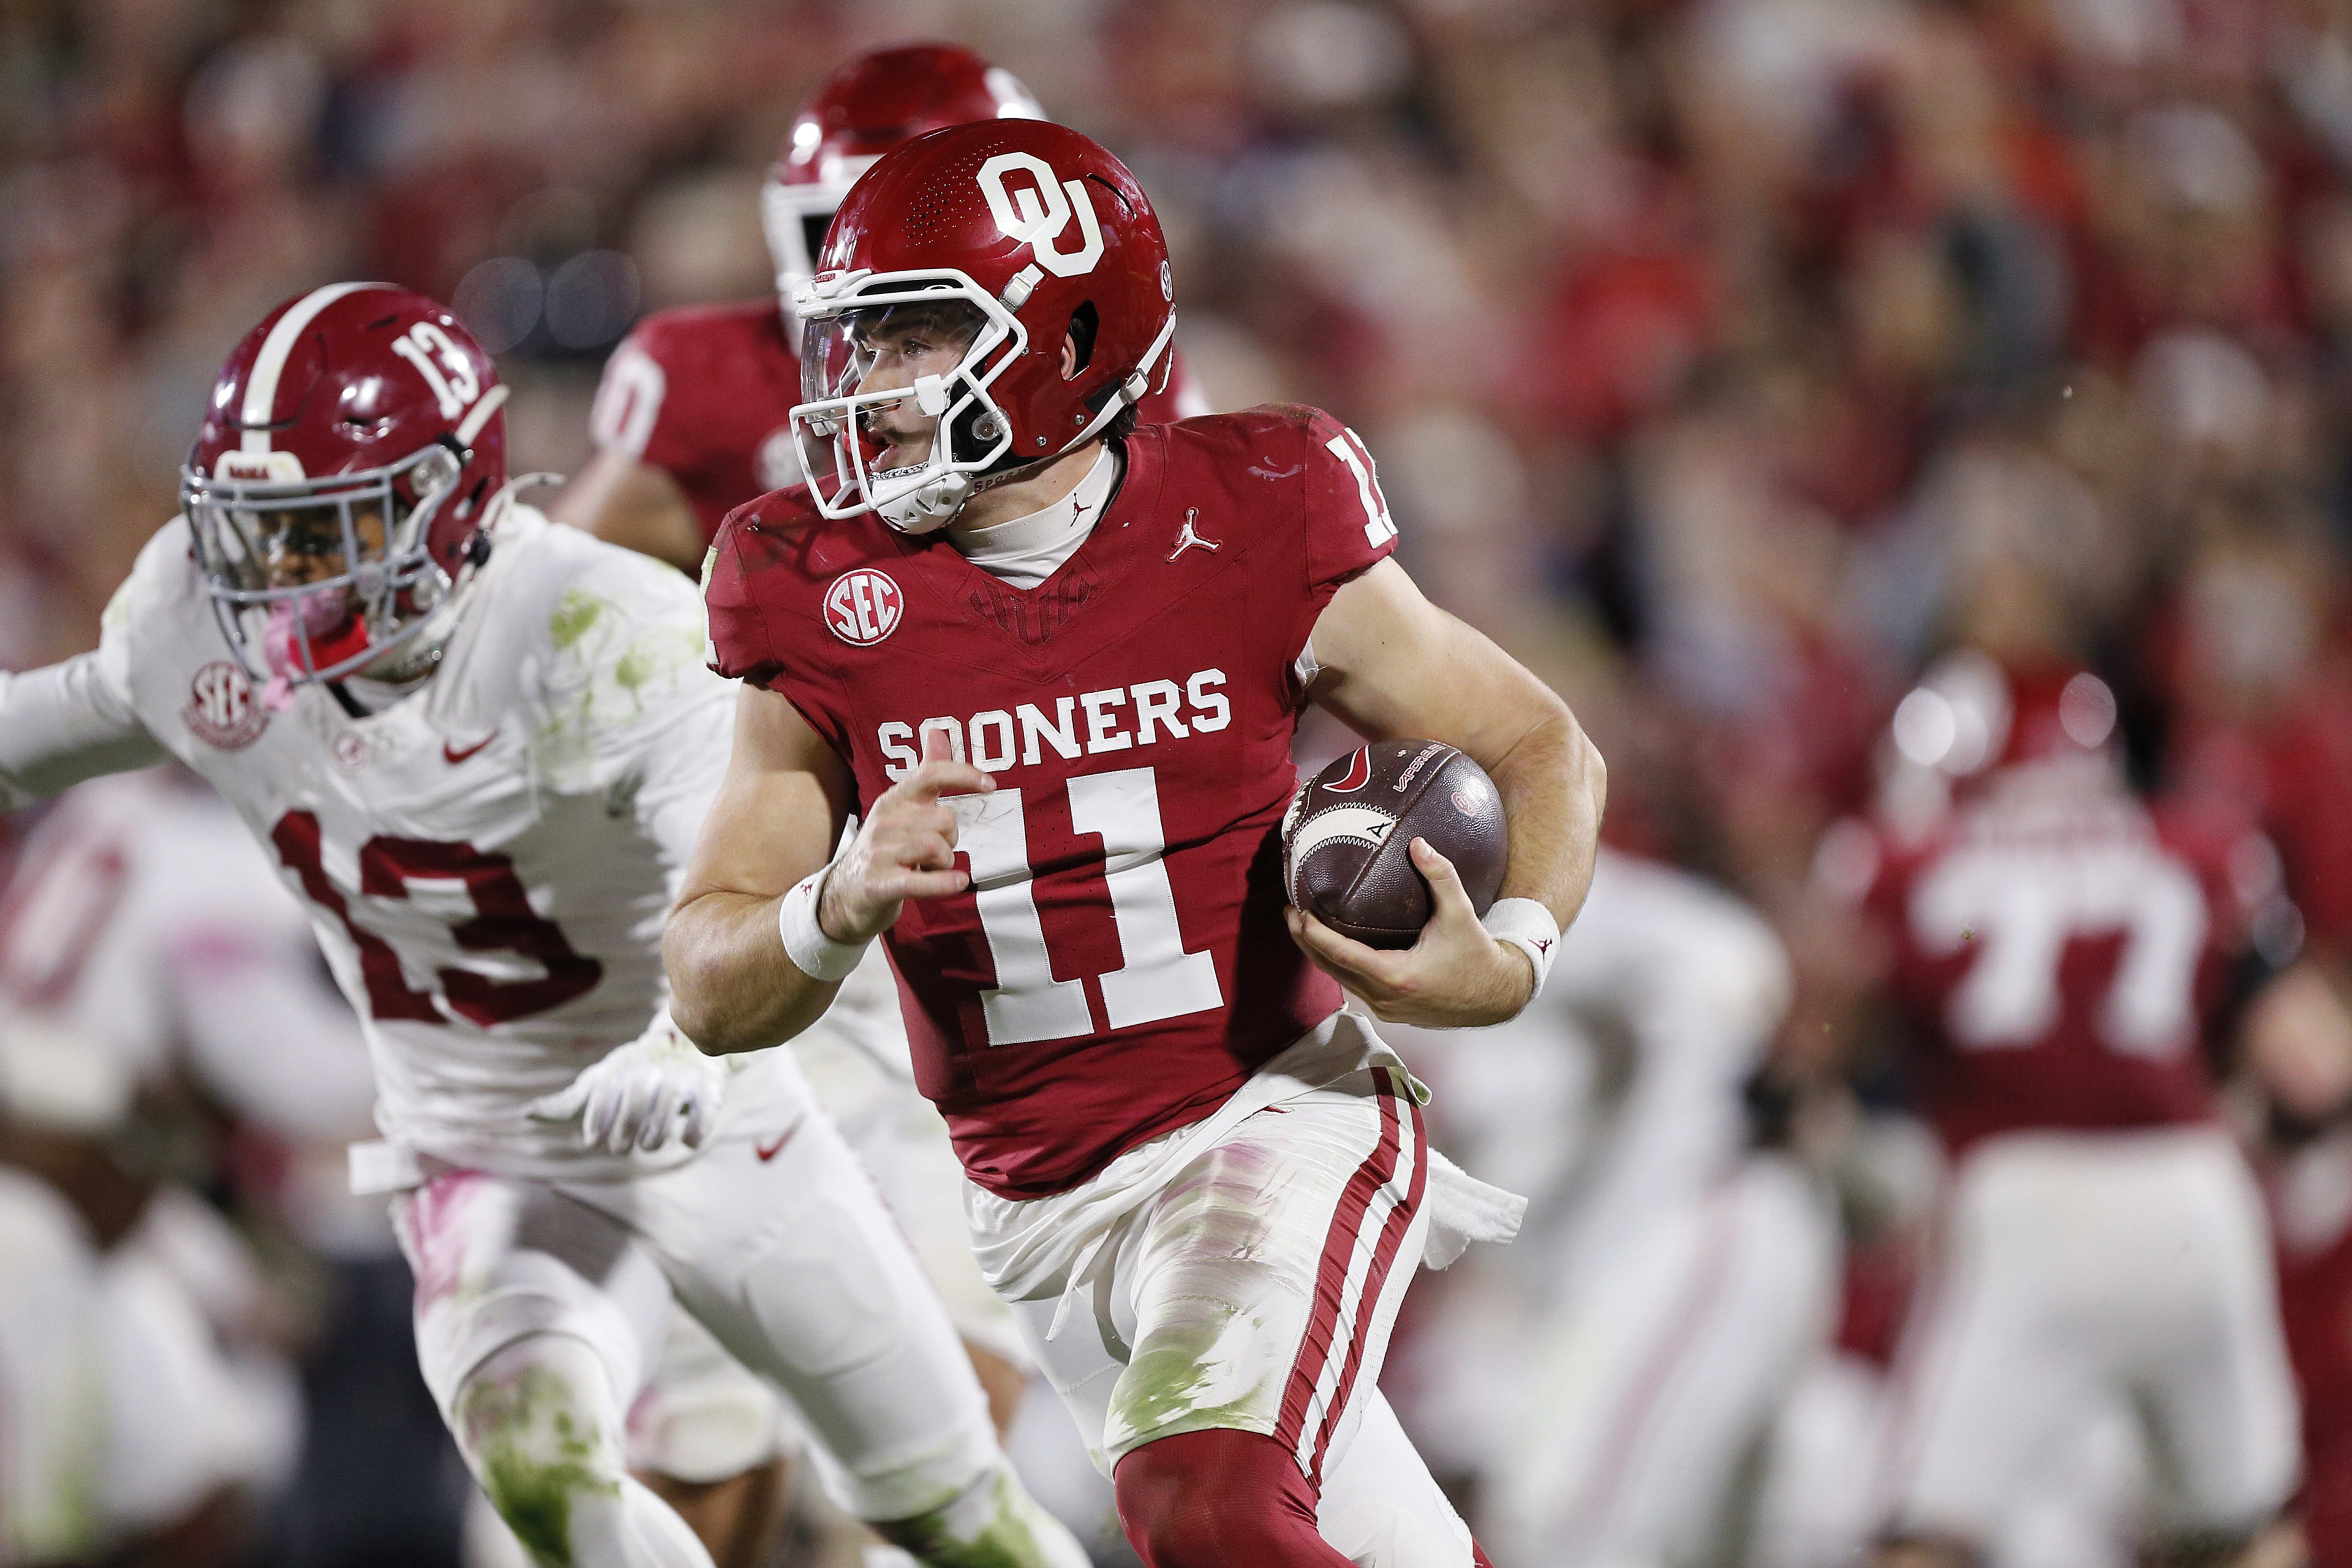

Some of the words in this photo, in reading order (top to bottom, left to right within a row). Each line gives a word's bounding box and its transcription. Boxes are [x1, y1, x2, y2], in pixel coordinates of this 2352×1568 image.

[976, 152, 1104, 277] OU
[391, 321, 480, 420] 13
[1325, 427, 1398, 549] 11
[830, 574, 896, 639] SEC
[195, 665, 251, 725] SEC
[878, 668, 1231, 783] SOONERS
[271, 808, 603, 1029] 13
[936, 766, 1224, 1046] 11
[1910, 853, 2206, 1057] 77
